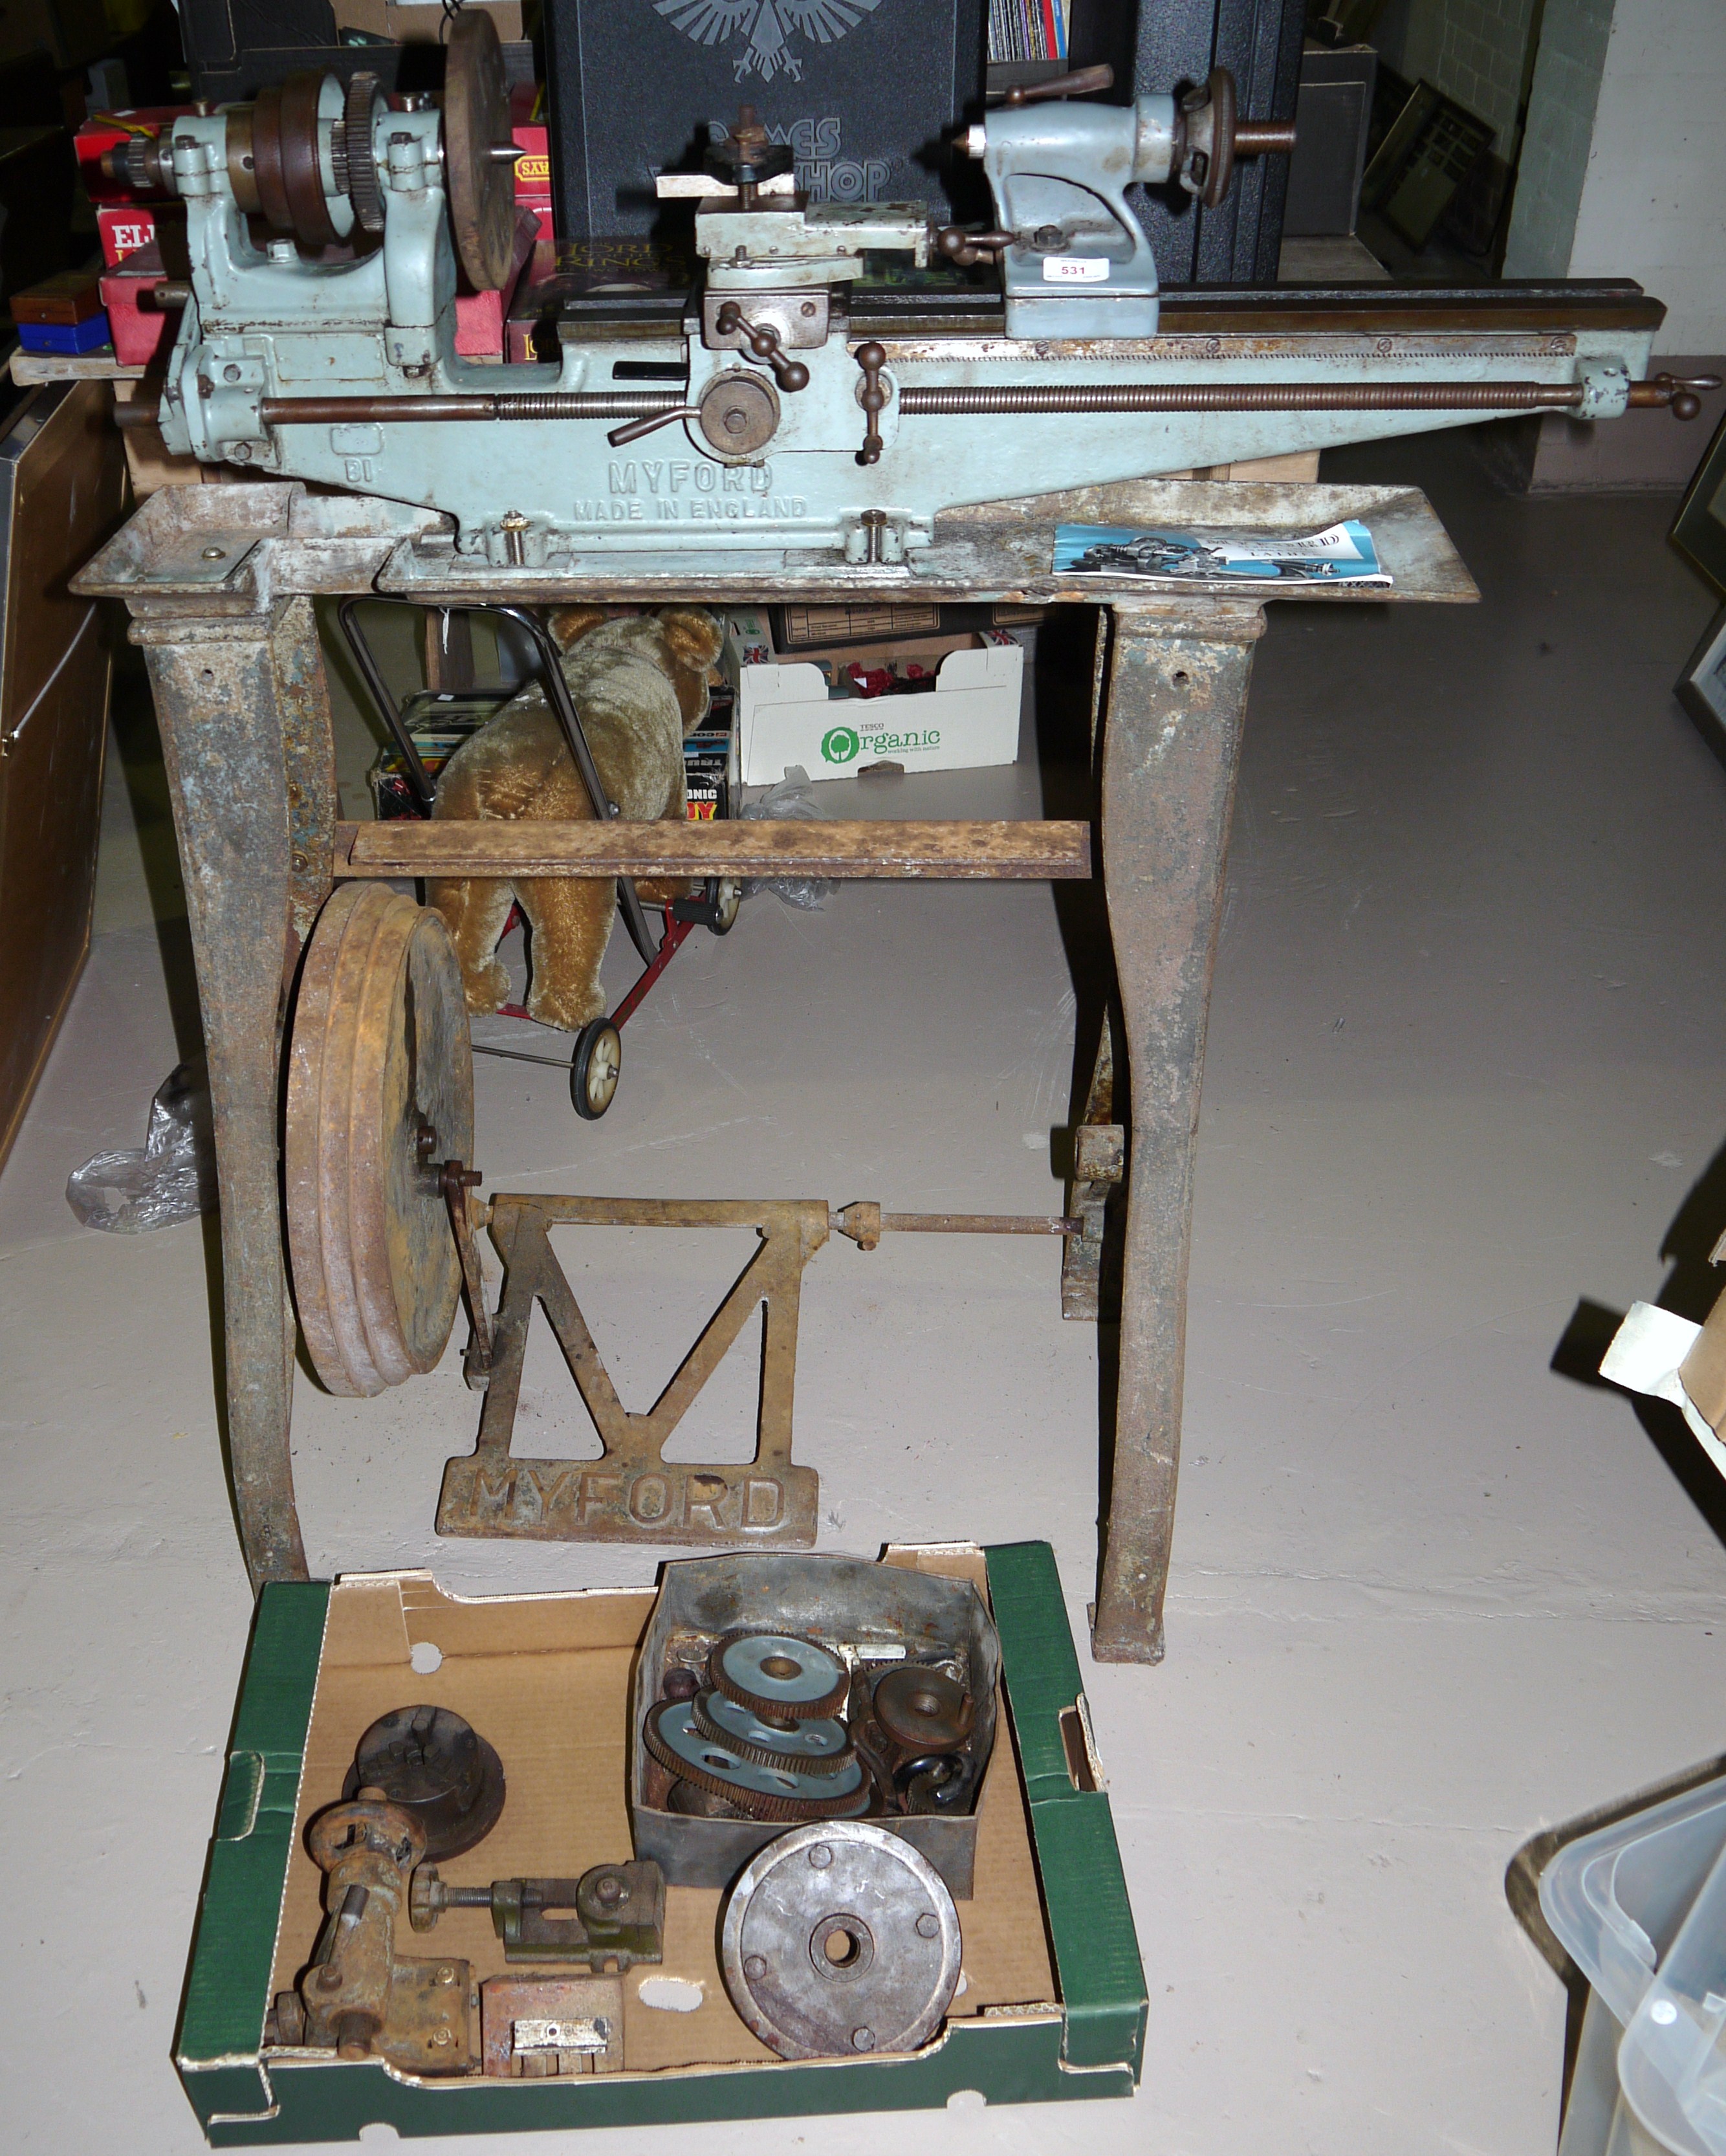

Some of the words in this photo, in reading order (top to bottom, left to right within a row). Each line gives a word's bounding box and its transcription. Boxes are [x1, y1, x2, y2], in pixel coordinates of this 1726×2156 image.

[706, 116, 841, 159] GMES
[1061, 266, 1085, 274] 531
[609, 459, 773, 494] MYFORD
[573, 499, 644, 520] MADE
[657, 498, 679, 519] IN
[690, 495, 809, 518] ENGLAND
[821, 726, 941, 764] Organic
[469, 1468, 786, 1534] MYFORD
